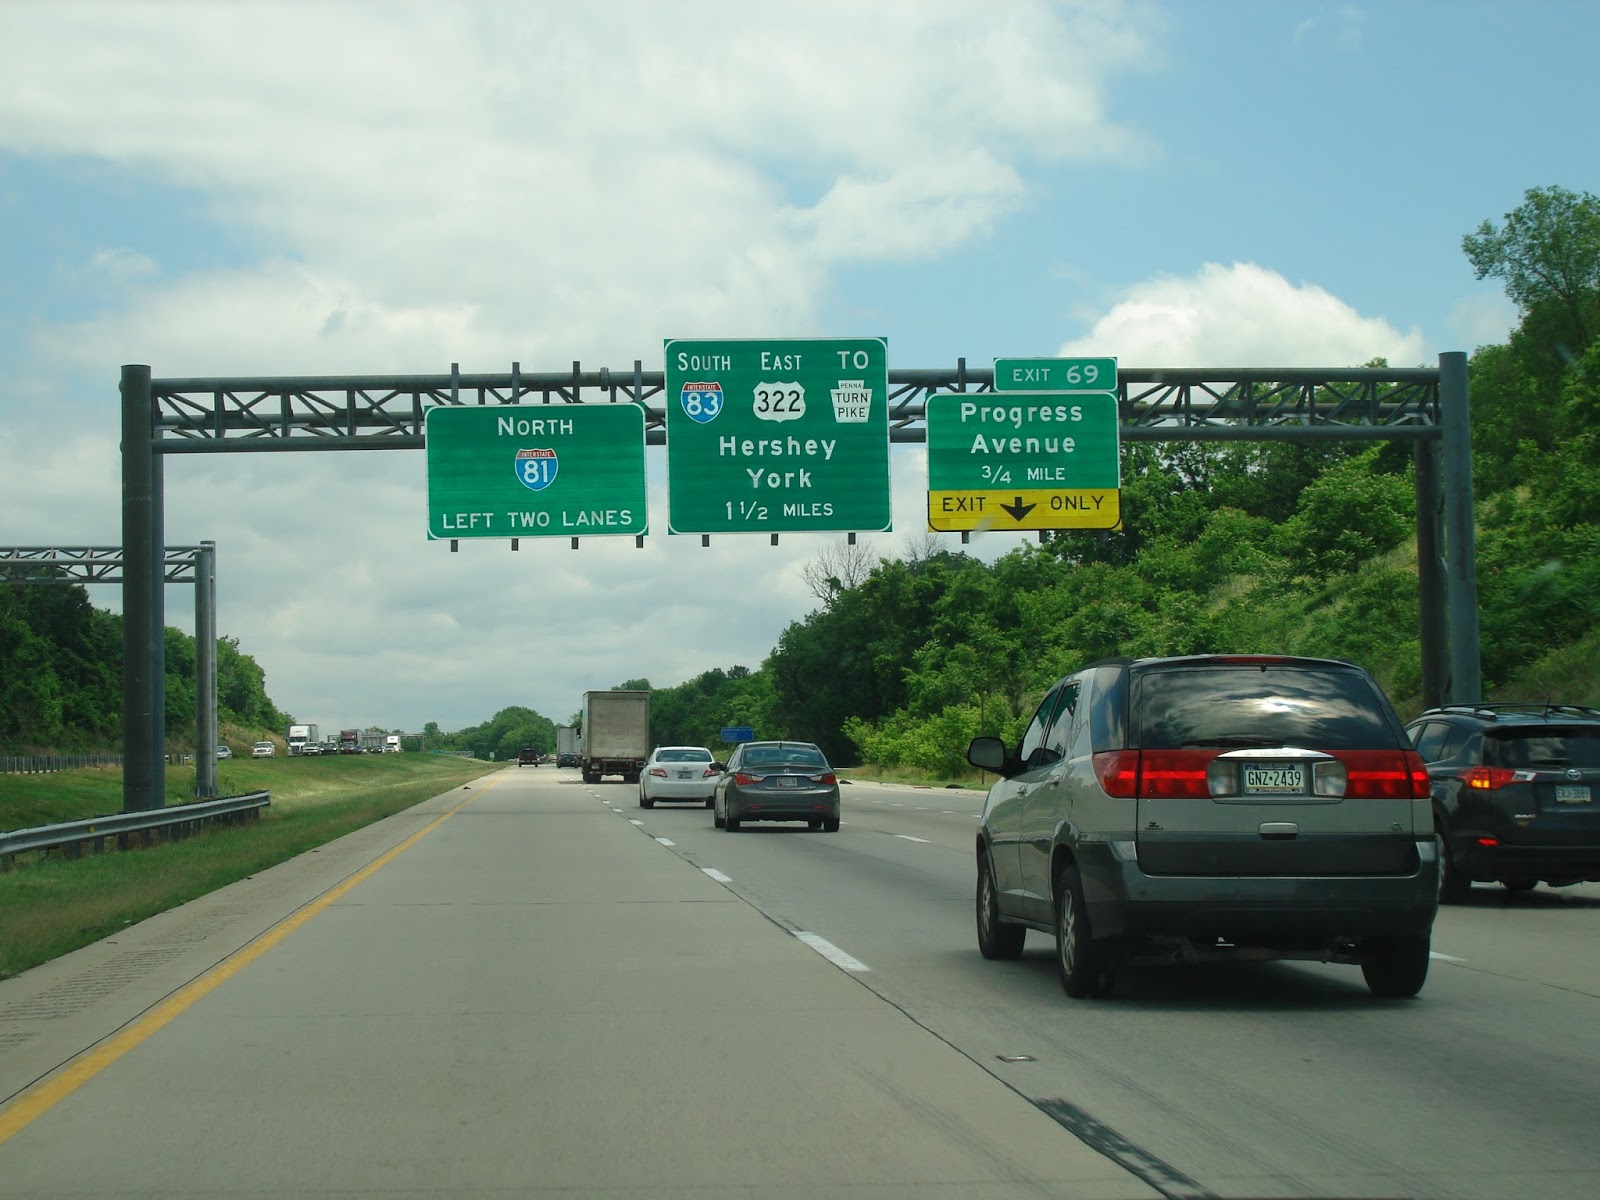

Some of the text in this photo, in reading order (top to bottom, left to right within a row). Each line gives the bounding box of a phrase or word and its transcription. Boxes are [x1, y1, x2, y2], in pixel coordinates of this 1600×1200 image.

[677, 352, 731, 371] SOUTH
[761, 352, 802, 370] EAST
[837, 350, 869, 370] TO
[1012, 365, 1099, 384] EXIT 69
[686, 392, 719, 416] 83
[757, 390, 801, 413] 322
[835, 393, 868, 403] TURN
[838, 408, 866, 418] PIKE
[960, 402, 1083, 429] Progress
[497, 417, 573, 435] NORTH
[719, 435, 837, 460] Hershey
[970, 433, 1076, 454] Avenue
[523, 460, 548, 483] 81
[746, 468, 812, 488] York
[981, 465, 1066, 484] 3/4 MILE
[783, 503, 834, 517] MILES
[942, 495, 1105, 512] EXIT ONLY
[442, 509, 632, 529] LEFT TWO LANES
